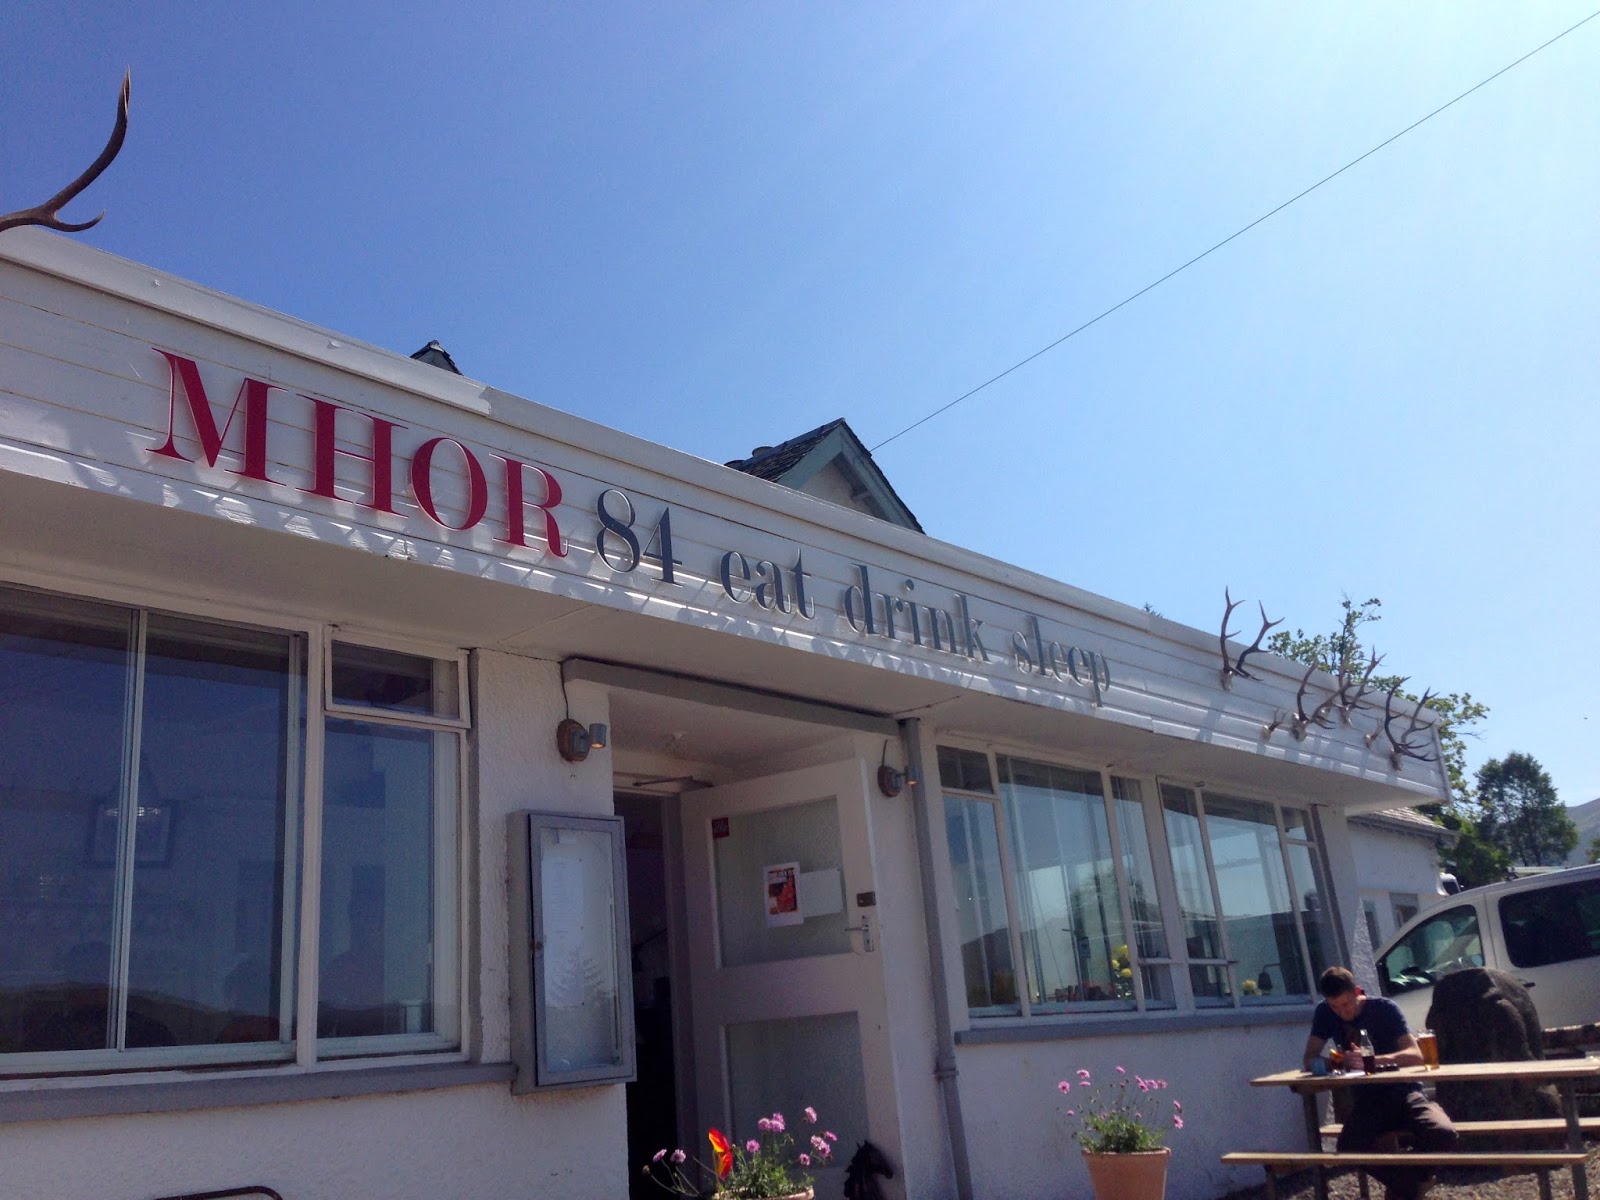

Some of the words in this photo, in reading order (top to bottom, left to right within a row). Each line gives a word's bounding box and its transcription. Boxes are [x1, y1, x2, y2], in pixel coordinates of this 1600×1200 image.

[145, 347, 568, 558] MHOR
[596, 488, 682, 586] 84
[720, 548, 816, 620] eat
[843, 564, 991, 662] drink
[1012, 615, 1110, 708] sleep
